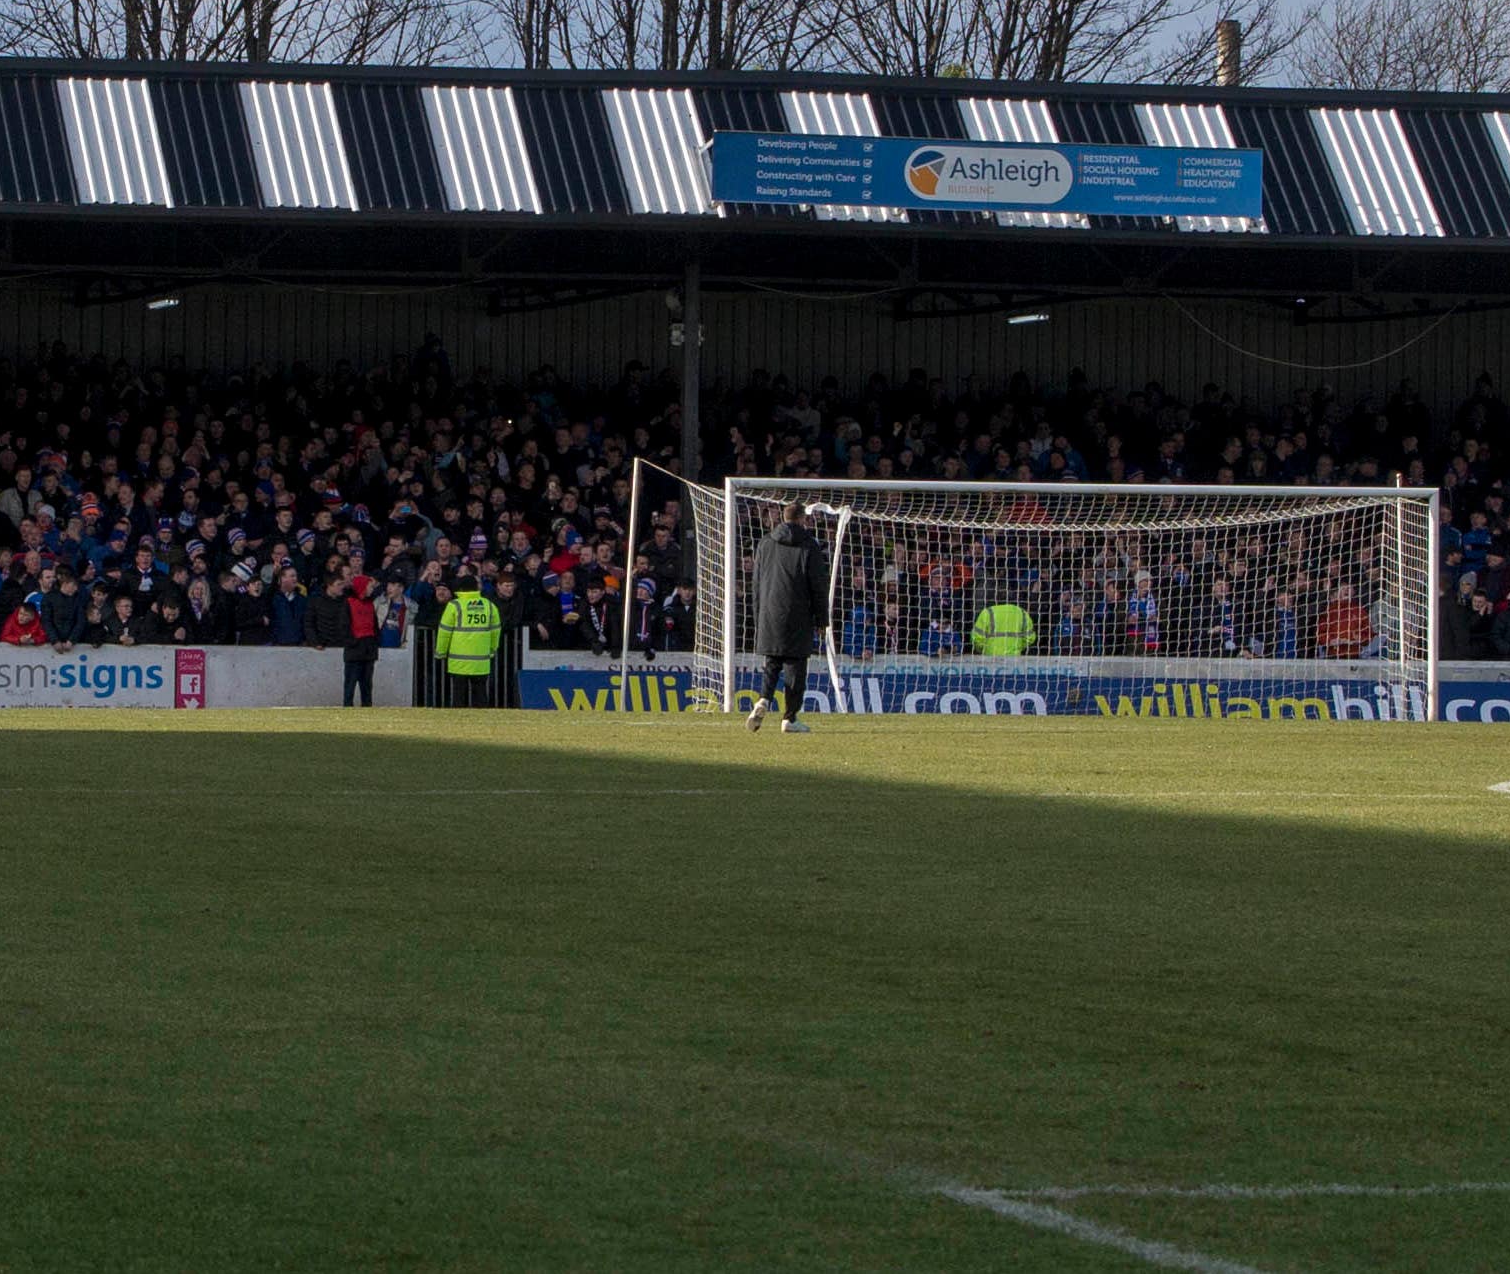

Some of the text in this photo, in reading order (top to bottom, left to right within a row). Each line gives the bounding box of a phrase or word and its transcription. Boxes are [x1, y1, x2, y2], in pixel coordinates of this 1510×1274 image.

[758, 138, 838, 151] Developing People
[757, 154, 860, 167] Delivering Communities
[1083, 154, 1140, 164] RESIDENTIAL
[1183, 158, 1243, 167] COMMERCIAL
[949, 157, 1060, 187] Ashleigh
[1083, 166, 1160, 176] SOCIAL HOUSING
[1183, 168, 1242, 178] HEALTHCARE
[756, 170, 856, 183] Constructing with Care
[1082, 176, 1136, 186] INDUSTRIAL
[1183, 179, 1235, 189] EDUCATION
[756, 186, 832, 197] Raising Standards
[467, 614, 487, 624] 750
